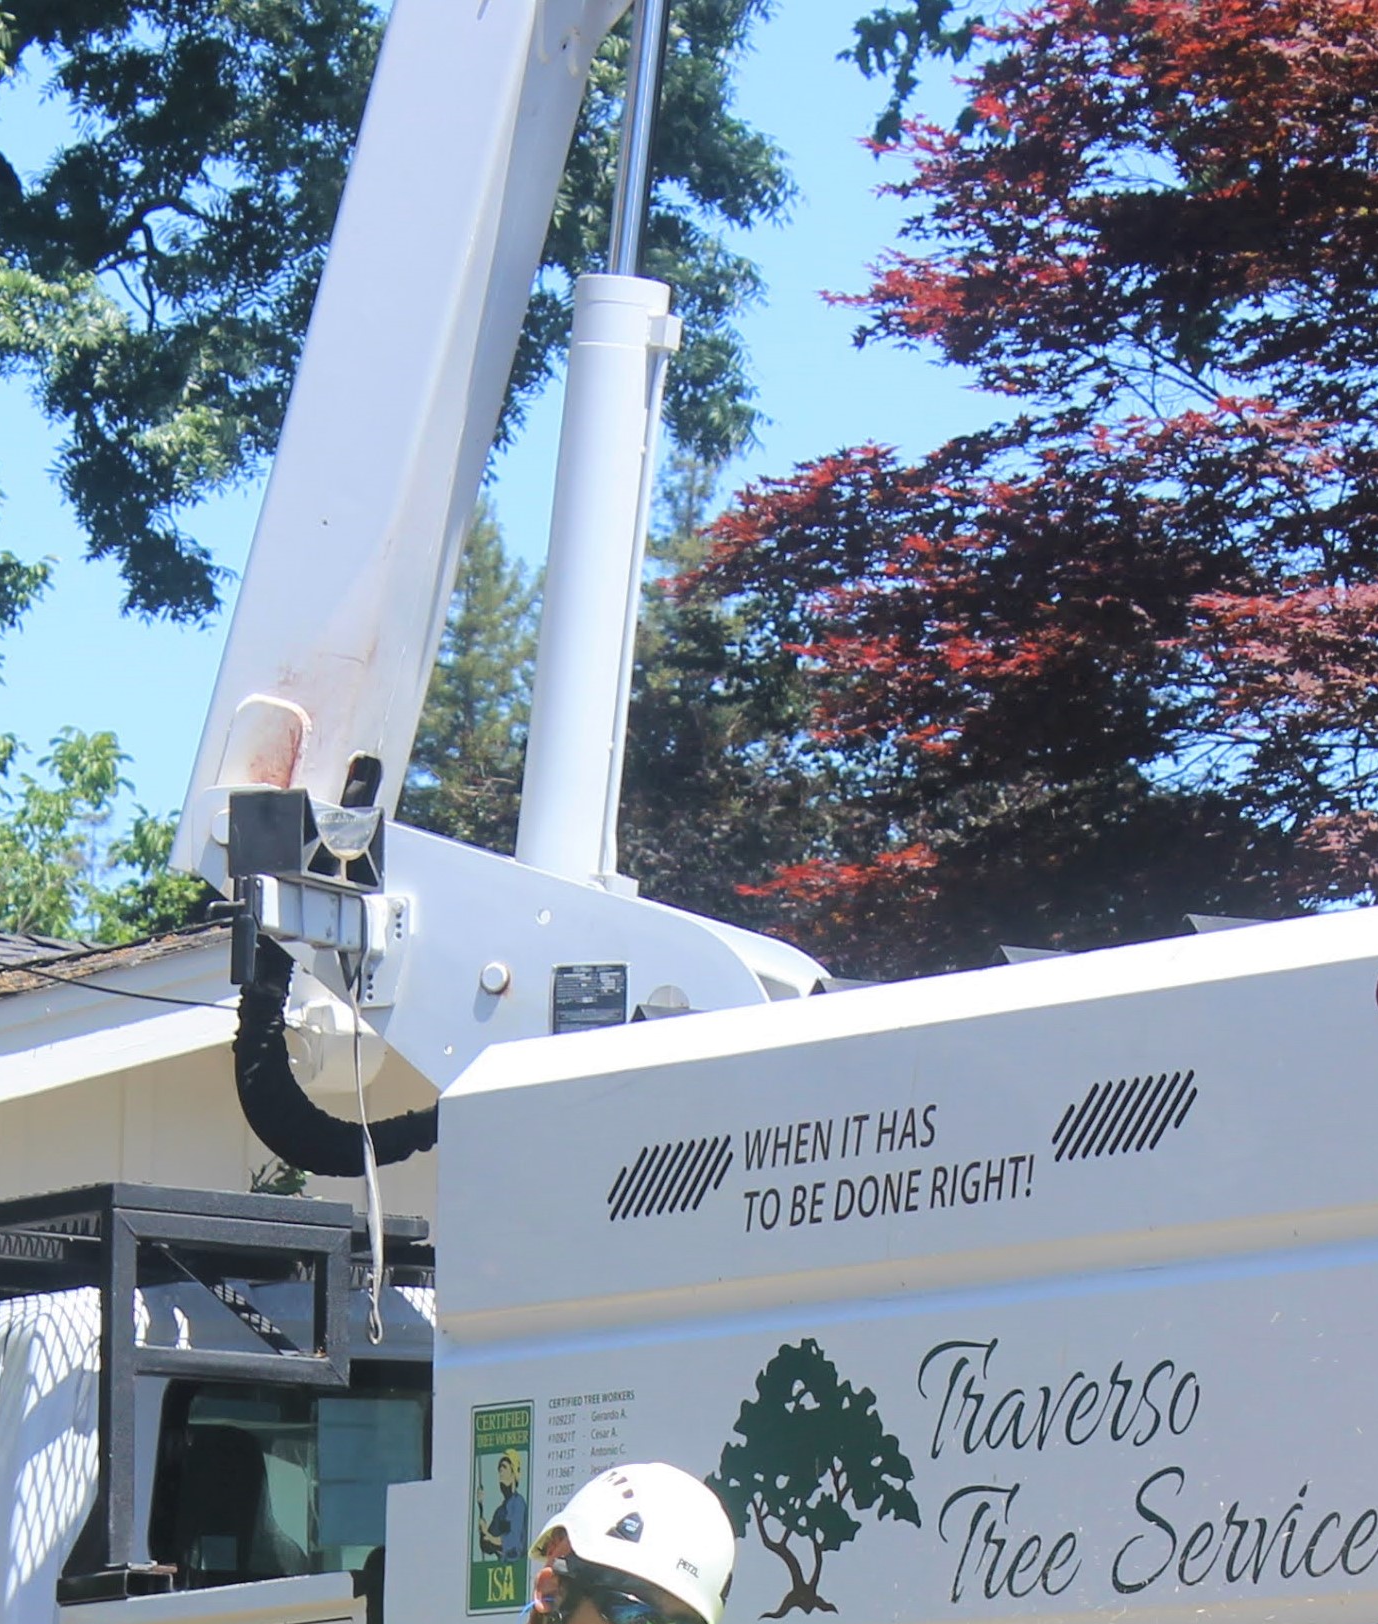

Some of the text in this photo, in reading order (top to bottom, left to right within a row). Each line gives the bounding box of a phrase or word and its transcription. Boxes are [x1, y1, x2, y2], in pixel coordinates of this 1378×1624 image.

[743, 1103, 938, 1171] WHEN IT HAS
[743, 1154, 1035, 1232] TO BE DONE RIGHT!
[476, 1410, 529, 1431] CERTIFIED
[584, 1393, 600, 1404] TREE
[602, 1390, 636, 1402] WORKERS
[918, 1338, 1200, 1459] Traverso
[939, 1483, 1082, 1602] Tree
[487, 1565, 515, 1602] ISA
